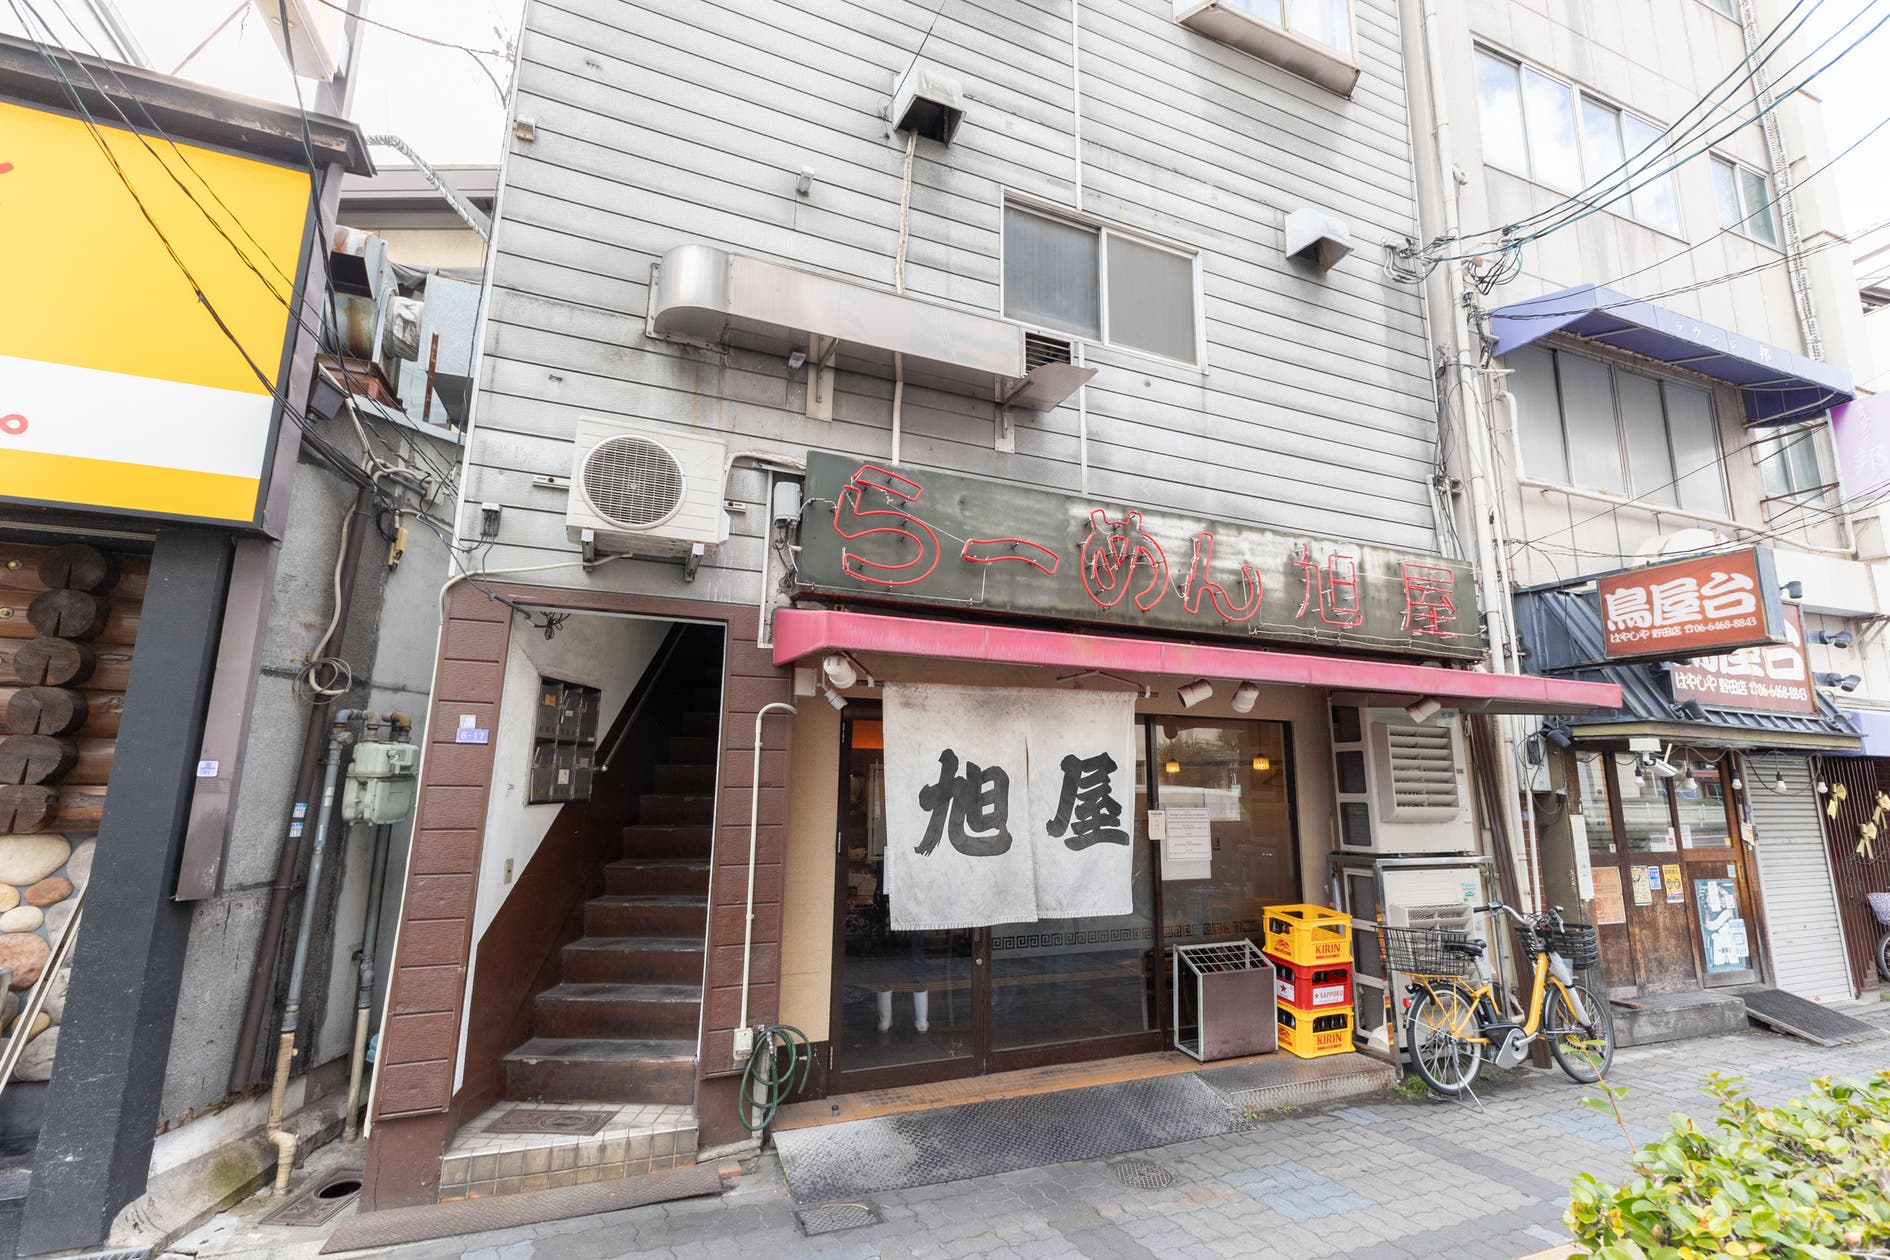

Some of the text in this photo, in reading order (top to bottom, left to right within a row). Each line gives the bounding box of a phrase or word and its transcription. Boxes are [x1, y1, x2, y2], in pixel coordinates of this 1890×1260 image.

[833, 464, 1462, 636] らーめん 旭屋
[1604, 571, 1756, 631] 鳥屋台
[1610, 629, 1650, 643] はやしや
[1652, 626, 1682, 638] 野田店
[1674, 671, 1717, 692] はやしや
[1718, 677, 1748, 696] 野田店
[461, 731, 485, 740] 6-17
[914, 748, 1130, 857] 旭屋
[1315, 943, 1340, 954] KIRIN
[1320, 989, 1344, 999] SAPPORO
[1316, 1033, 1342, 1045] KIRIN
